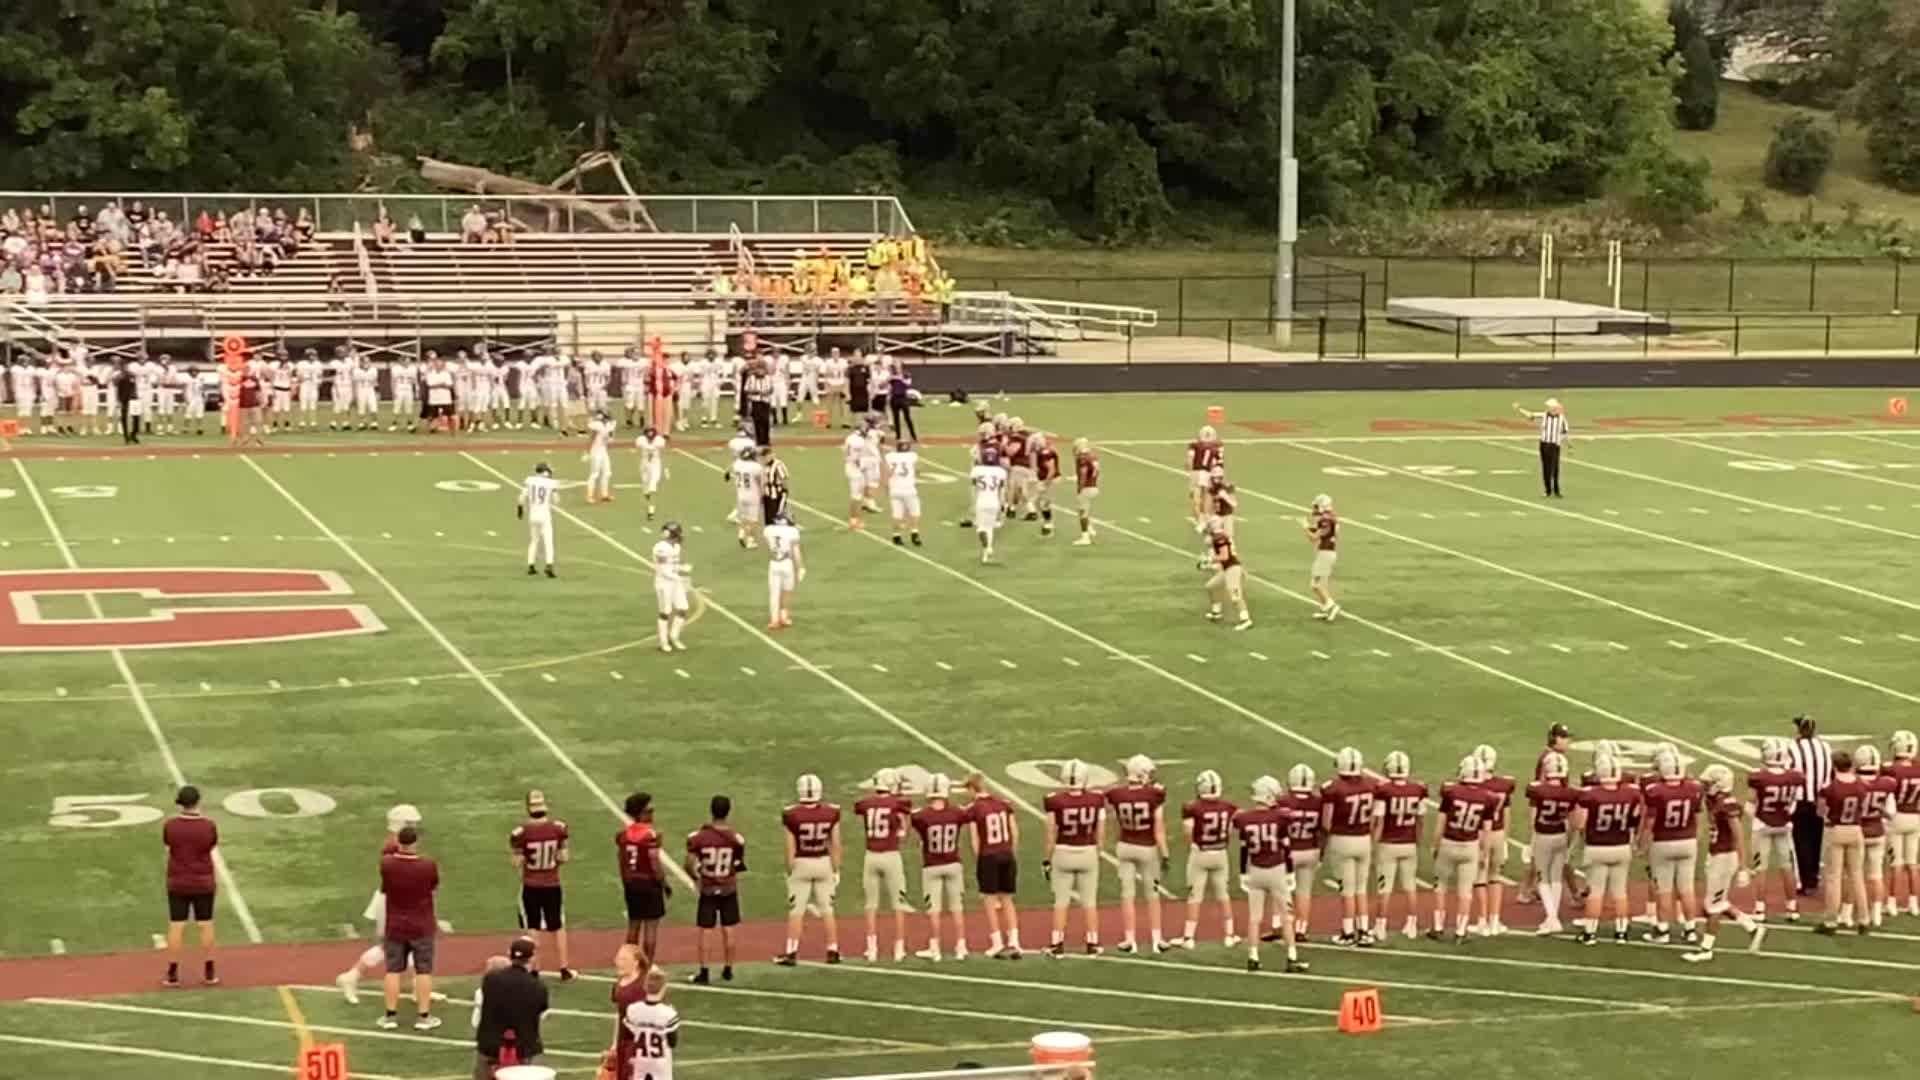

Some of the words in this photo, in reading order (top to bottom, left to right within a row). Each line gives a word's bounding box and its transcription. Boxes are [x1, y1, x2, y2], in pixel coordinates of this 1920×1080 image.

[531, 484, 547, 505] 19
[0, 567, 389, 652] C
[1346, 793, 1374, 825] 72
[1391, 797, 1420, 826] 45
[1451, 800, 1485, 831] 36
[1664, 799, 1691, 827] 61
[1763, 786, 1800, 815] 24
[866, 807, 892, 838] 16
[985, 811, 1009, 844] 81
[1063, 806, 1097, 836] 54
[1595, 803, 1630, 831] 64
[799, 821, 831, 851] 25
[927, 823, 958, 853] 88
[1244, 823, 1278, 853] 34
[526, 839, 557, 870] 30
[701, 847, 732, 877] 28
[1352, 995, 1376, 1026] 40
[634, 1031, 664, 1058] 49
[306, 1050, 340, 1080] 50
